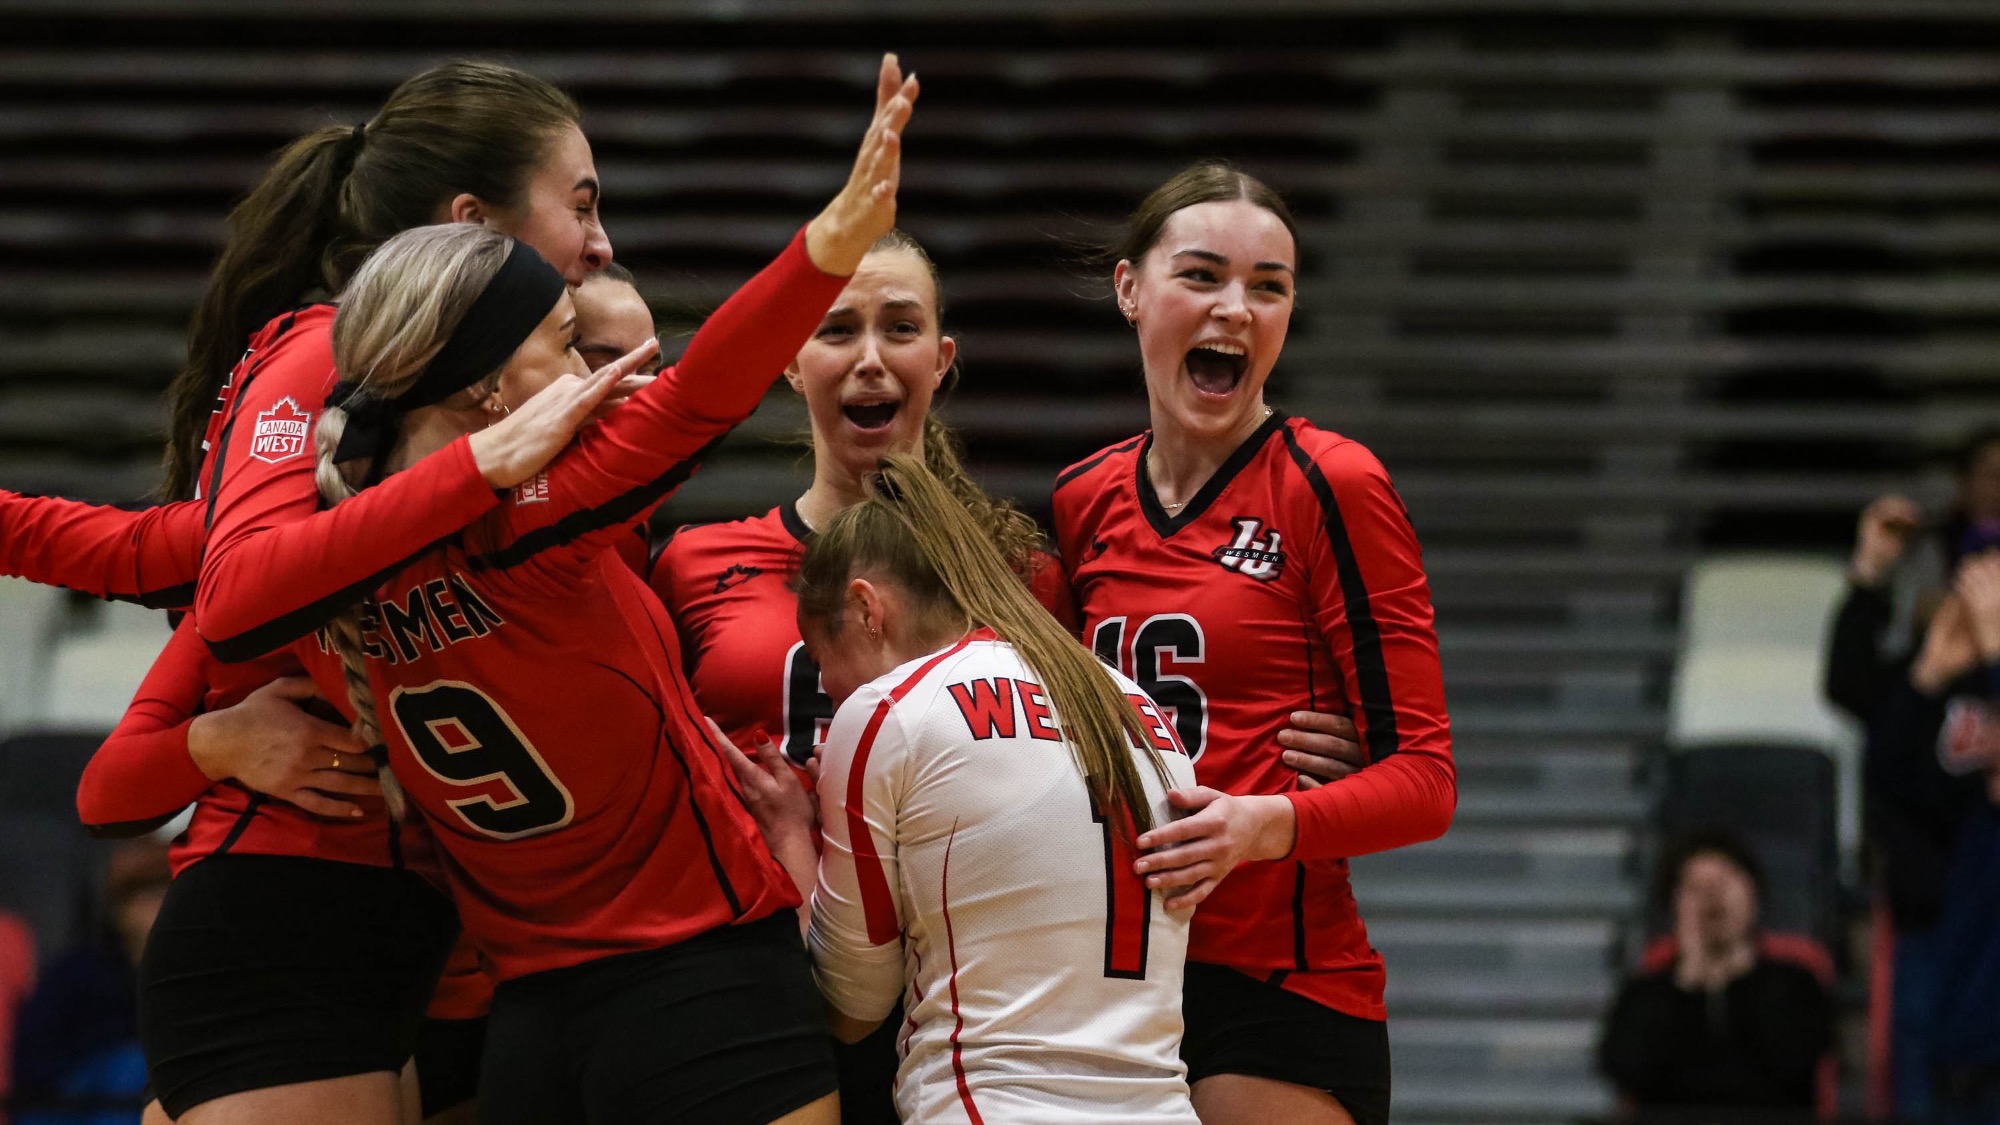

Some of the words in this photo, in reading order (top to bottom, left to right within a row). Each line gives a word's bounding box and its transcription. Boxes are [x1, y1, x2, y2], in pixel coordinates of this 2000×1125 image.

[257, 437, 300, 452] WEST
[260, 422, 303, 434] CANADA
[1225, 550, 1279, 562] WESMEN
[946, 676, 1187, 756] WEE
[388, 679, 575, 841] 9
[1084, 774, 1150, 981] 1
